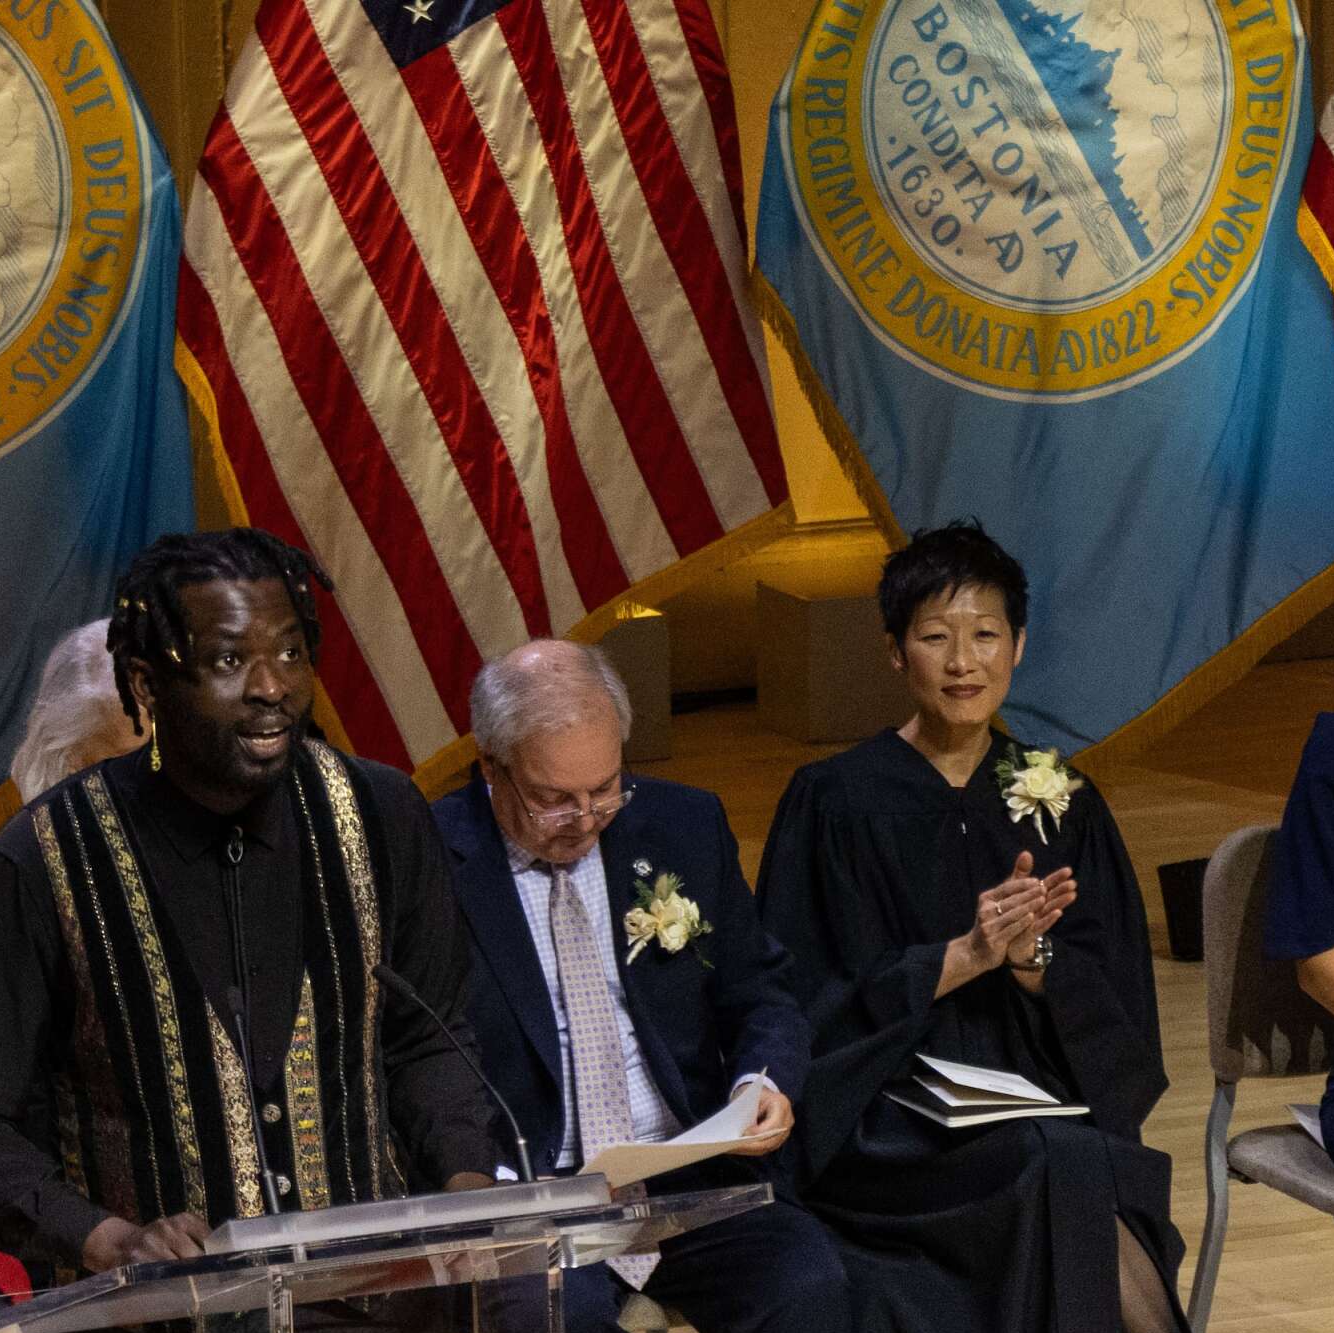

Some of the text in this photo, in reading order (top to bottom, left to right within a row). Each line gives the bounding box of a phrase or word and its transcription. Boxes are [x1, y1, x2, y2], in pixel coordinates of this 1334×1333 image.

[53, 38, 116, 118] SIT
[888, 54, 994, 223] CONDITA
[911, 2, 1079, 280] BOSTONIA
[1235, 53, 1284, 184] DEUS
[79, 138, 128, 267] DEUS
[805, 77, 902, 293] REGIMINE
[886, 274, 1041, 376] DONATA
